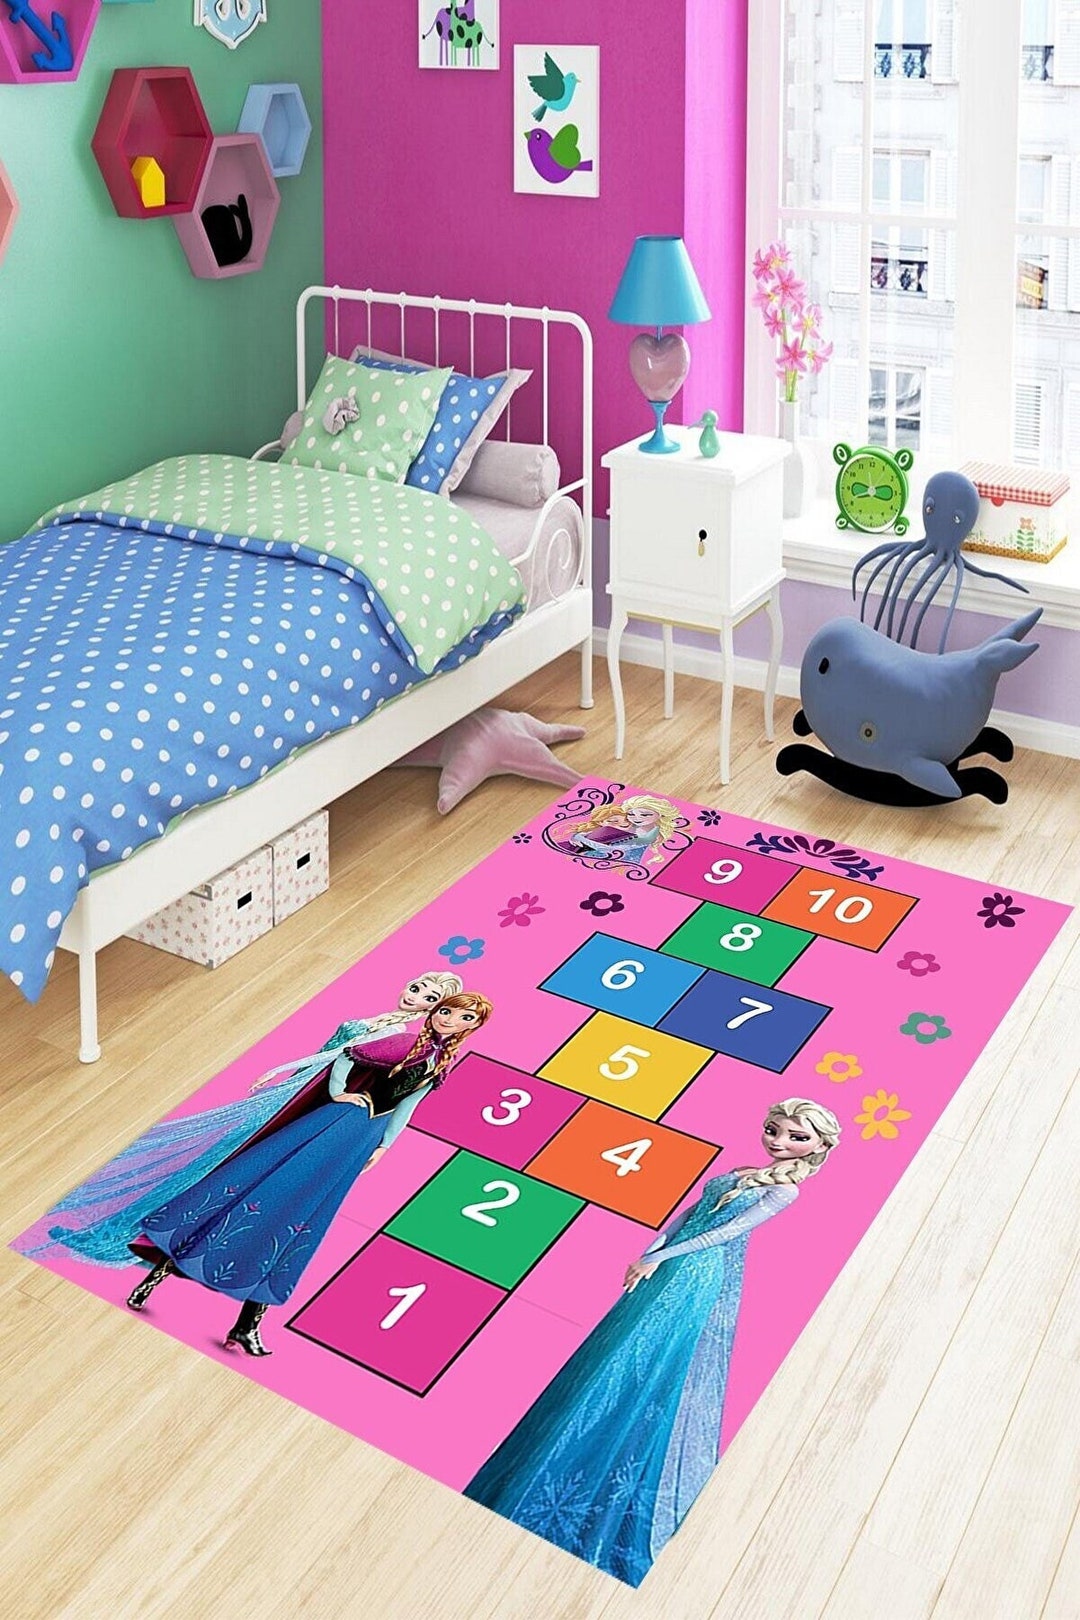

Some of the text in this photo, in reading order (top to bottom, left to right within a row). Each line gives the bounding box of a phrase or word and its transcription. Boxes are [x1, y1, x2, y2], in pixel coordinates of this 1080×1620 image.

[703, 858, 744, 886] 9
[807, 887, 874, 925] 10
[718, 921, 763, 952] 8
[600, 958, 646, 990] 6
[726, 996, 775, 1030] 7
[598, 1044, 651, 1081] 5
[480, 1087, 533, 1127] 3
[600, 1137, 653, 1178] 4
[460, 1179, 521, 1228] 2
[379, 1282, 427, 1331] 1
